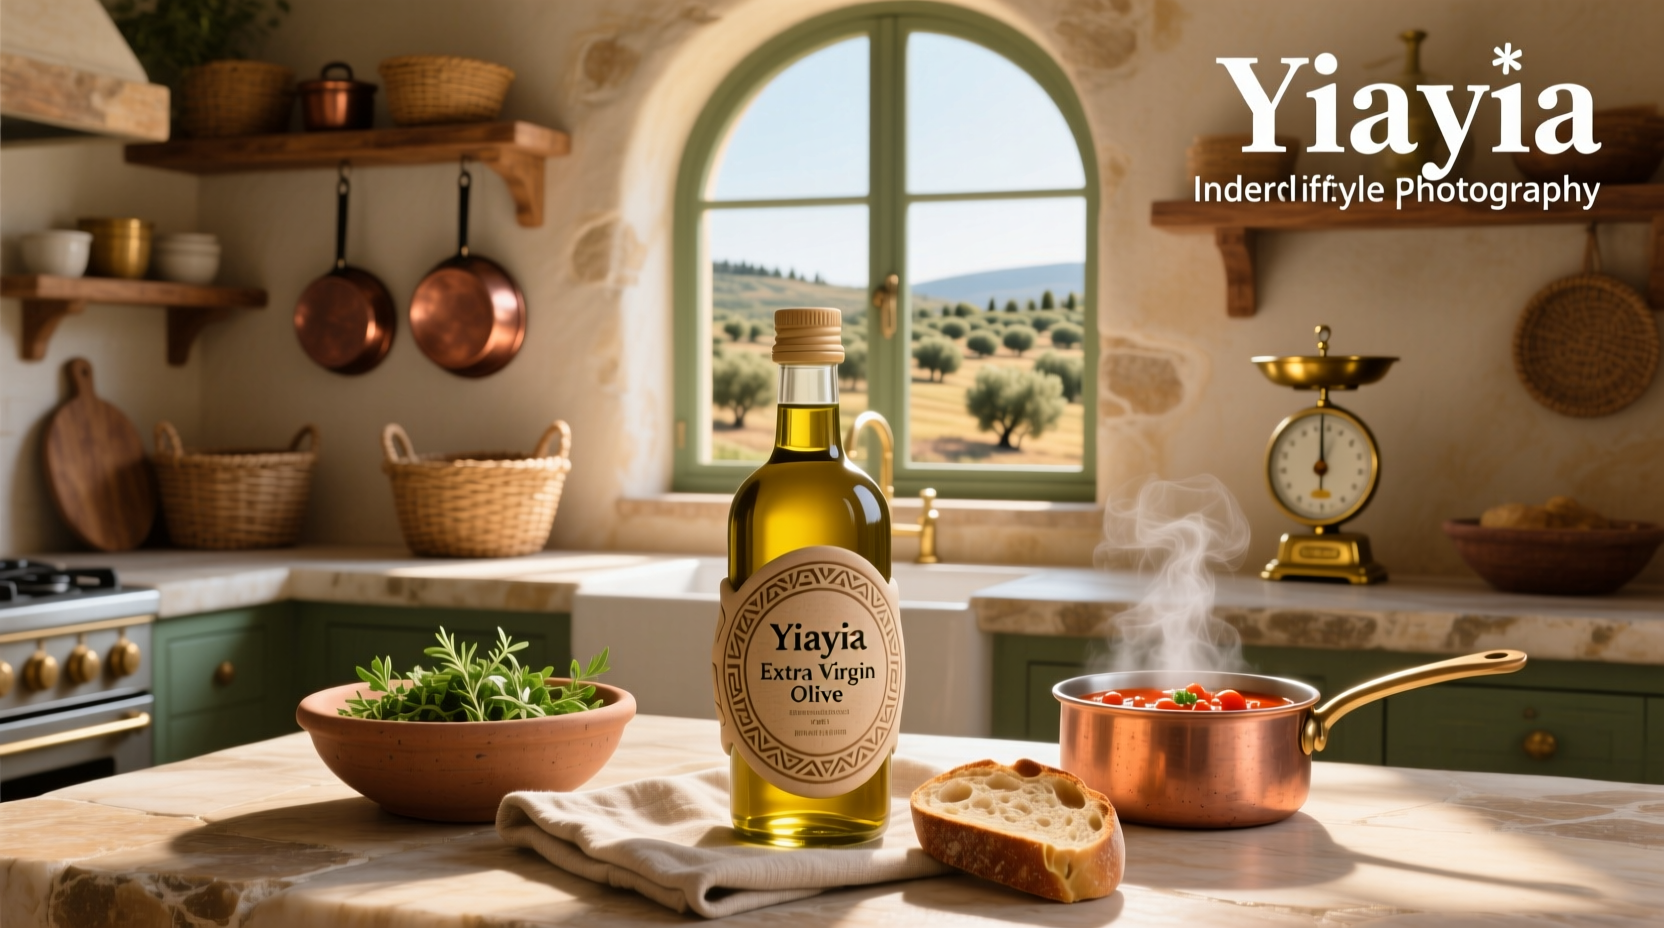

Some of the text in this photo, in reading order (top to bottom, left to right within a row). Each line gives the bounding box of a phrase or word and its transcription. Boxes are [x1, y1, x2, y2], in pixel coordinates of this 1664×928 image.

[769, 622, 868, 660] Yiayia
[760, 661, 876, 686] Extra Virgin
[790, 685, 844, 703] Olive
